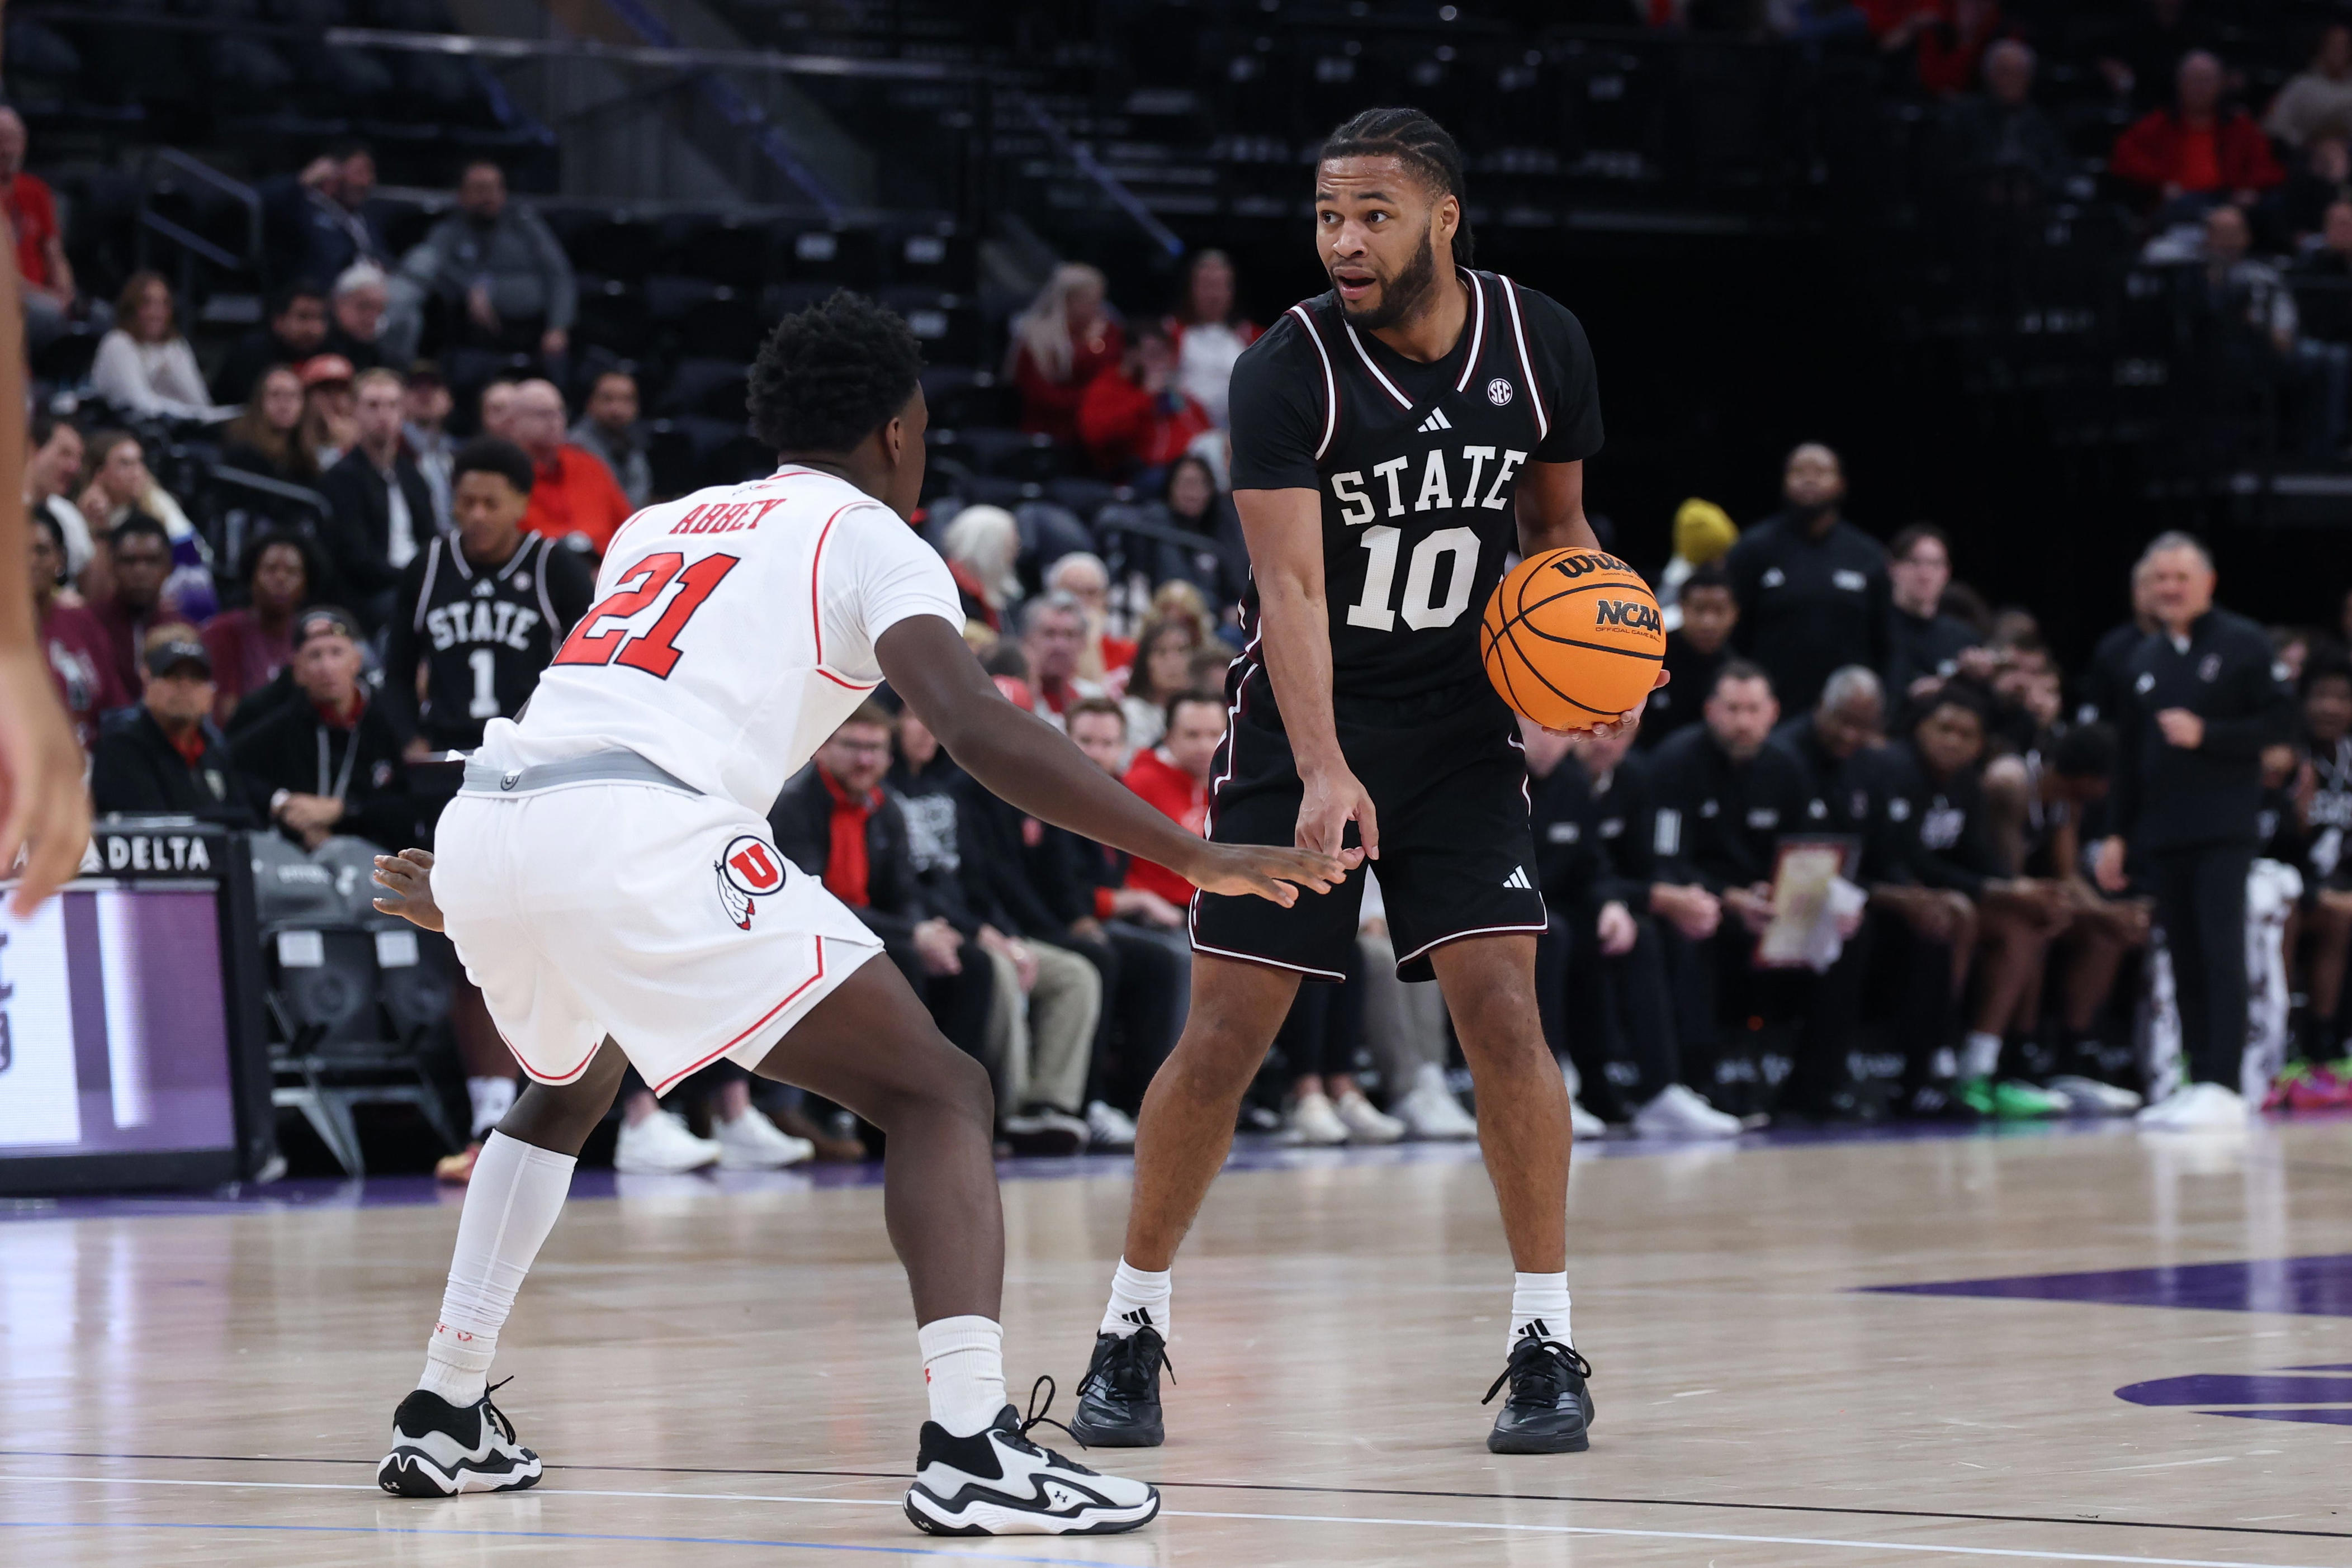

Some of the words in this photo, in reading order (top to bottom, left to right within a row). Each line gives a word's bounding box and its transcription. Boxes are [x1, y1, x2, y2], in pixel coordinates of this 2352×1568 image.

[1489, 380, 1511, 404] SEC
[1331, 445, 1528, 526] STATE
[669, 498, 788, 534] ABBEY
[1346, 524, 1482, 632] 10
[1550, 553, 1643, 578] Wils
[425, 600, 541, 652] STATE
[551, 551, 741, 680] 21
[1596, 599, 1662, 637] NCAA
[1631, 629, 1649, 638] GAME
[467, 648, 501, 719] 1
[107, 835, 211, 871] DELTA
[728, 843, 778, 889] U
